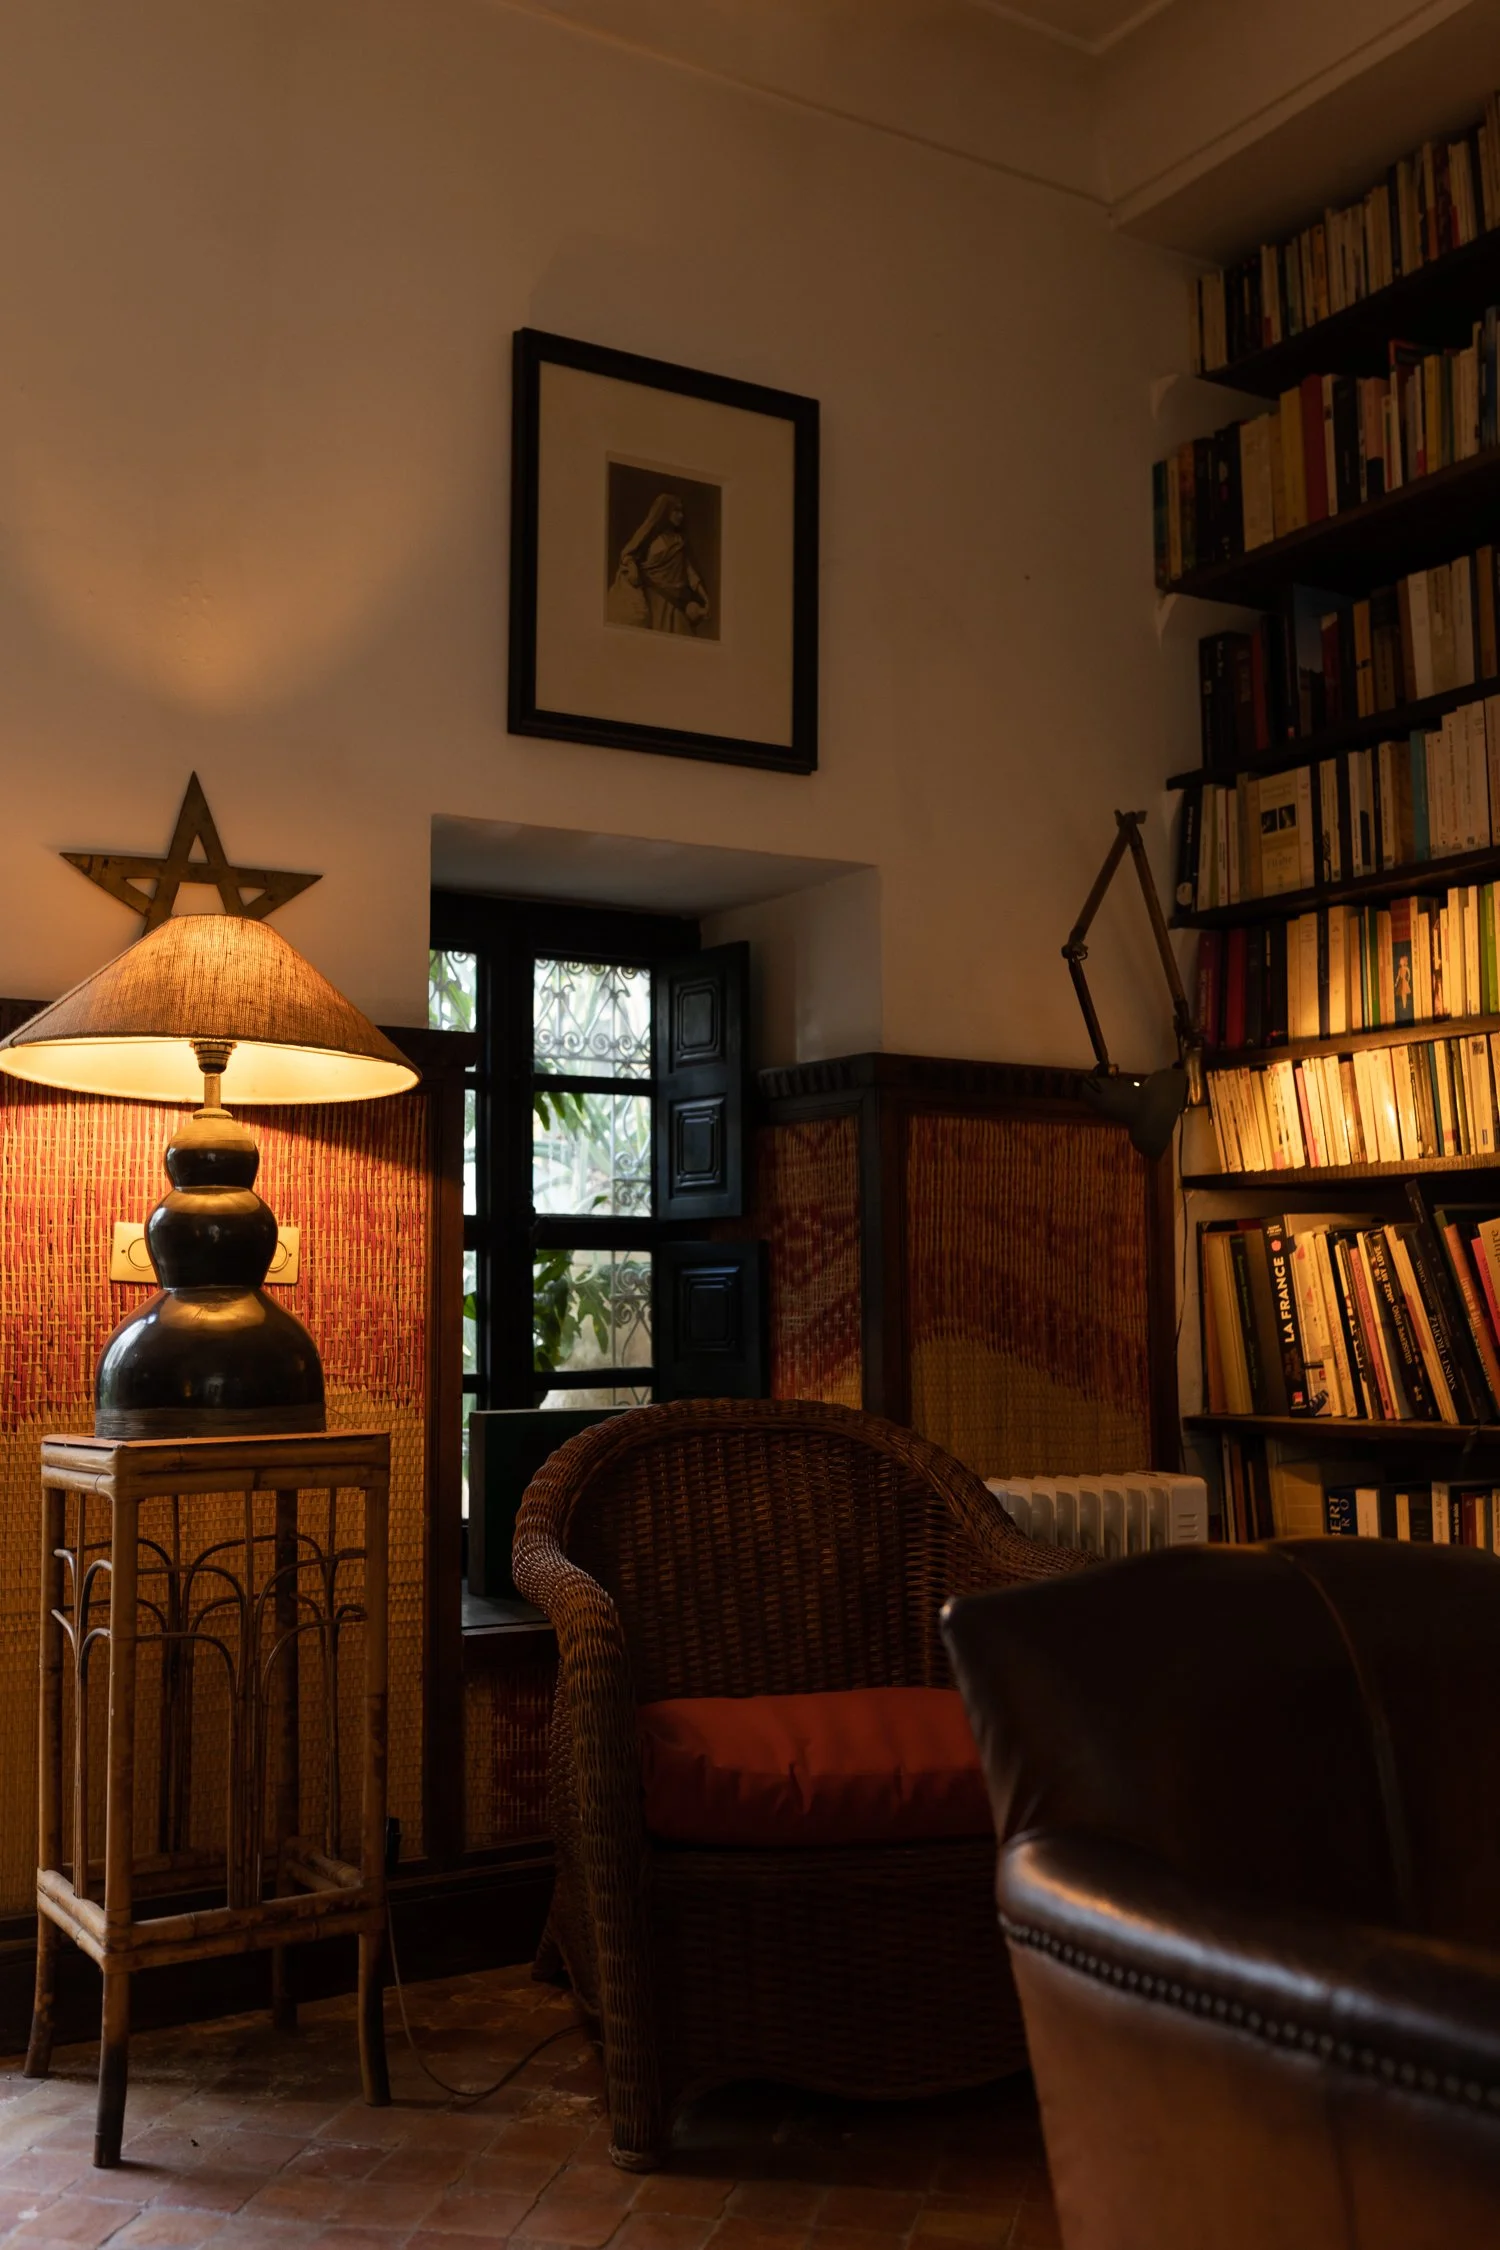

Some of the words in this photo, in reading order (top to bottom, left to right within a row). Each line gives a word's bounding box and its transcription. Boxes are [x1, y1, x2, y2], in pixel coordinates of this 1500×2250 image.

[1373, 1245, 1385, 1266] LOVE
[1273, 1256, 1294, 1321] FRANCE
[1383, 1281, 1395, 1303] JAZZ
[1284, 1322, 1296, 1343] LA
